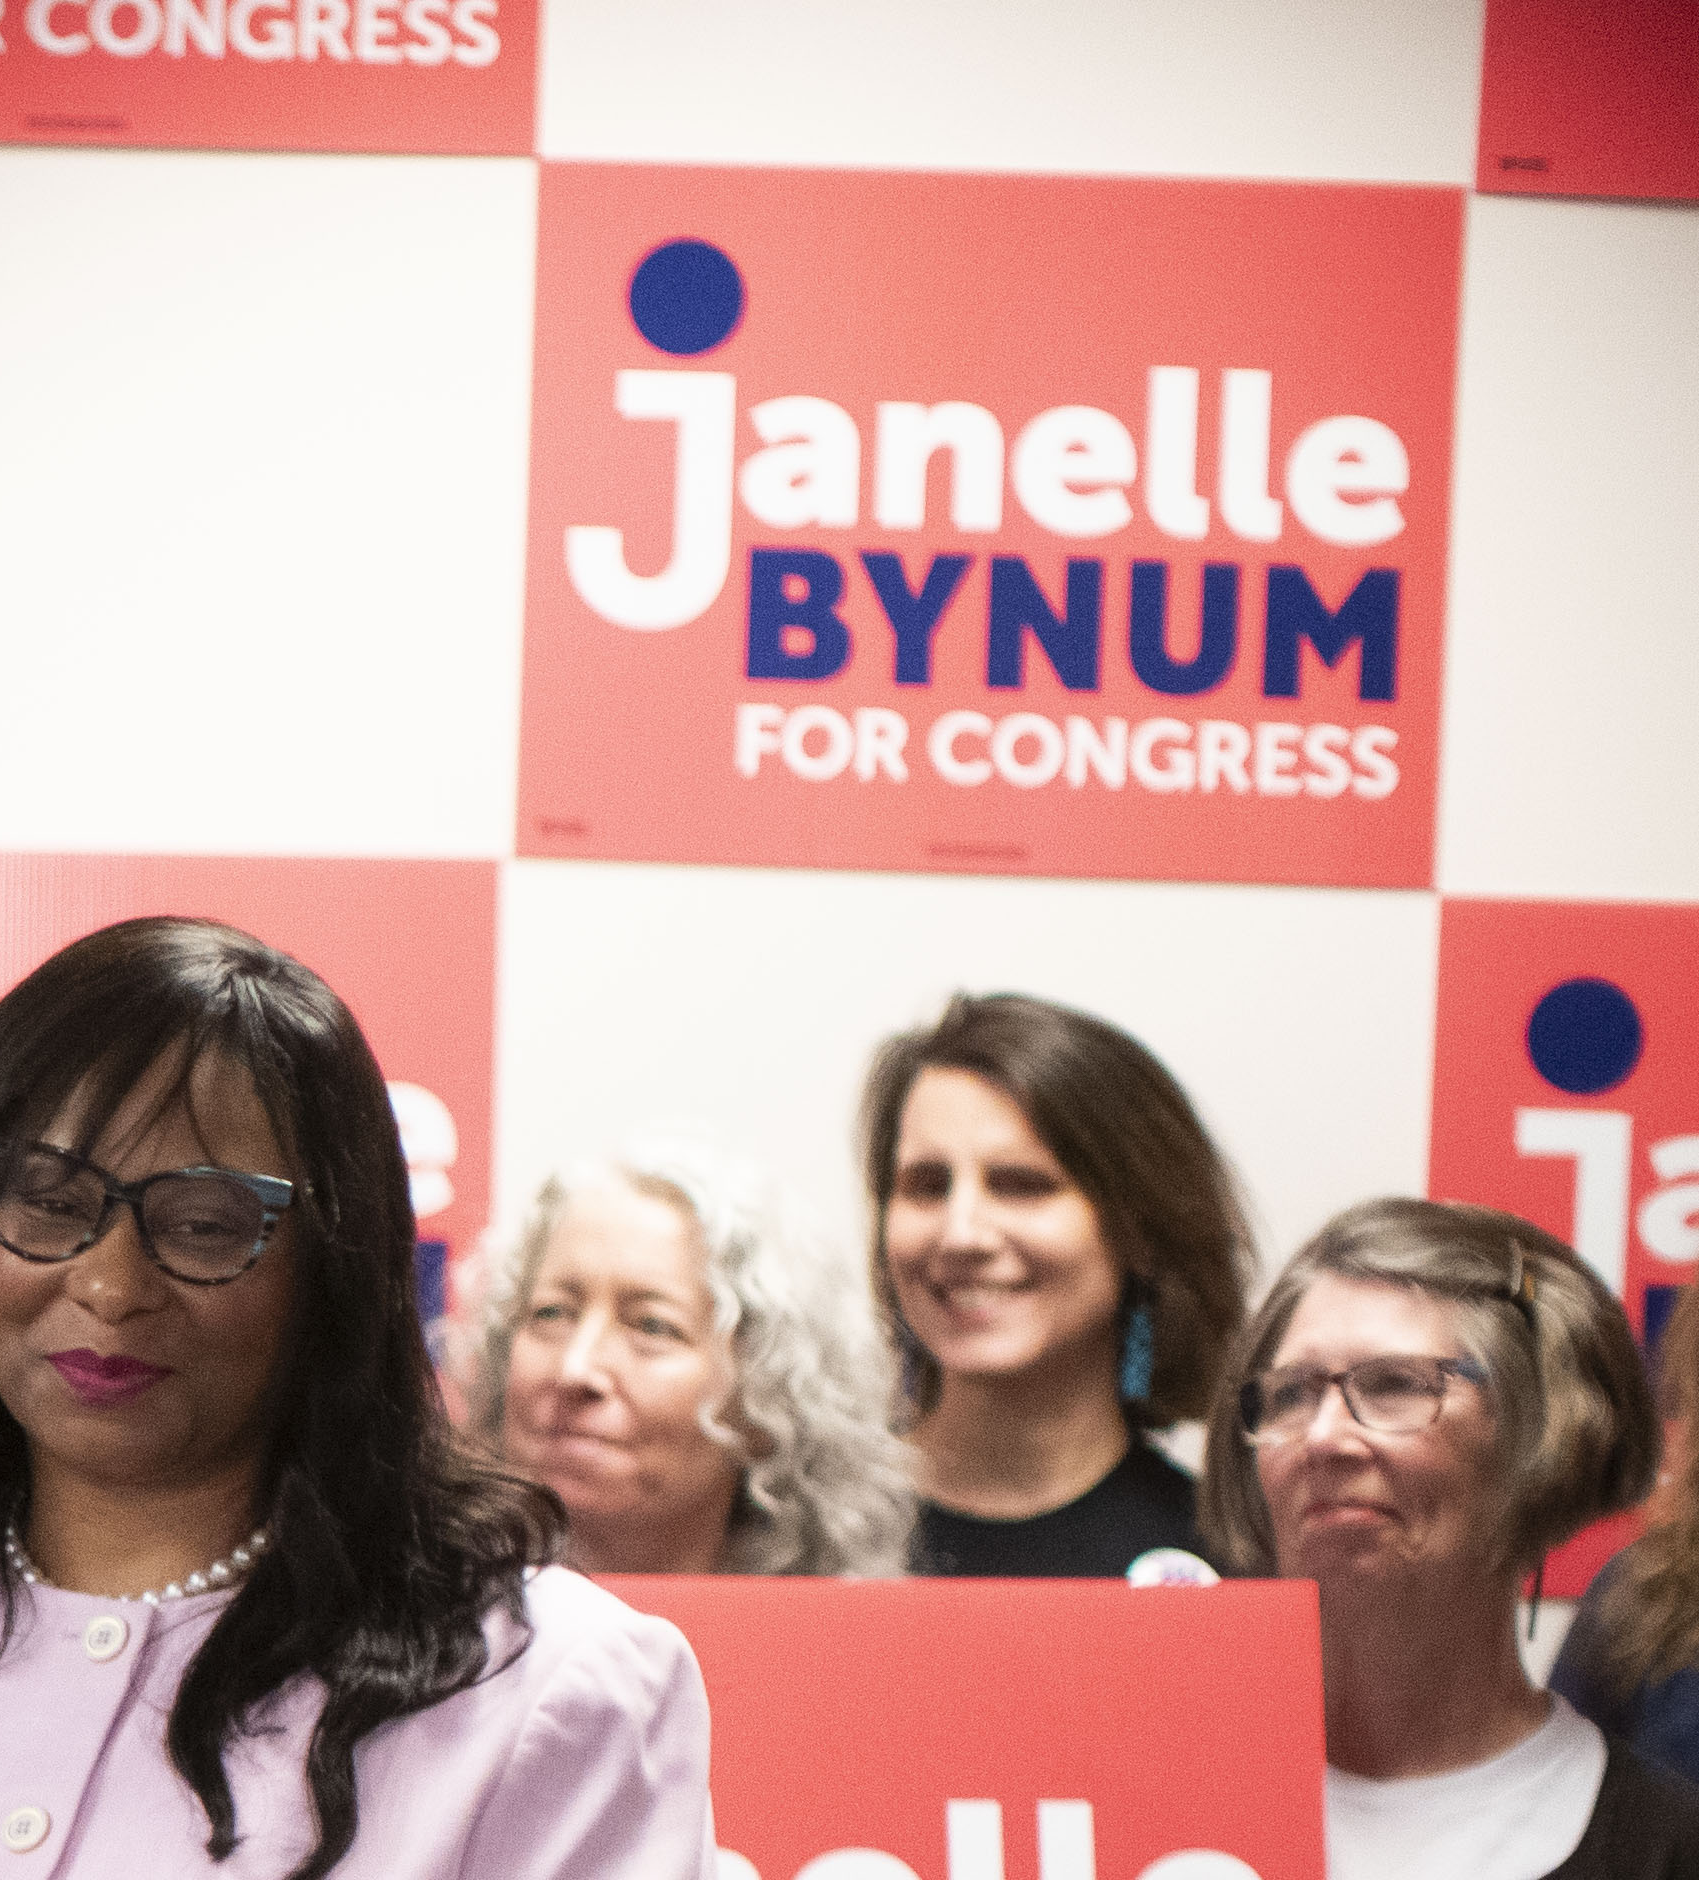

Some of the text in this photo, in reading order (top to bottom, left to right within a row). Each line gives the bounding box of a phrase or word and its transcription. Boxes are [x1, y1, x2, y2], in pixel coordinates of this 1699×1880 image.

[24, 0, 501, 66] CONGRESS
[745, 545, 1403, 702] BYNUM
[735, 702, 1401, 798] FOR CONGRESS
